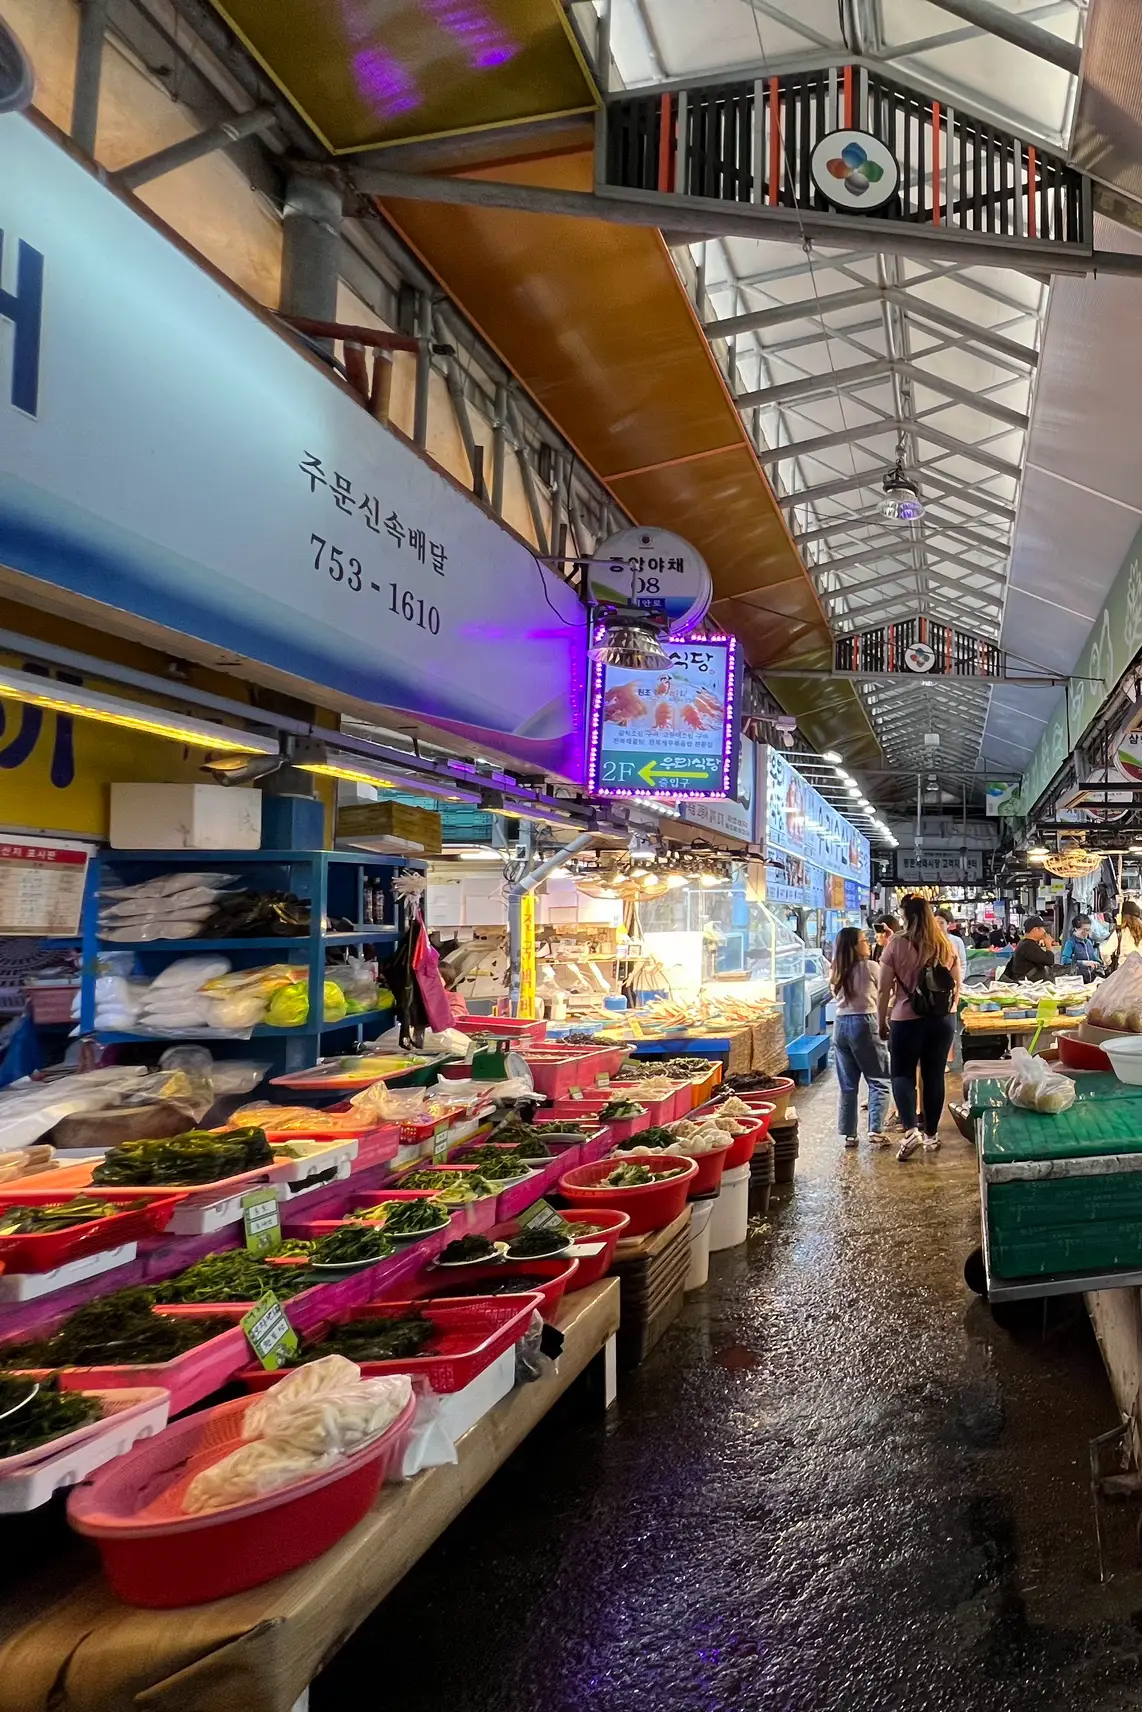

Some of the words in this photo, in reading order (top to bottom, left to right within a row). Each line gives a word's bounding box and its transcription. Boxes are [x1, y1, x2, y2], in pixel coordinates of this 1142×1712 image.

[299, 450, 448, 577] 주문신속배달
[310, 532, 441, 636] 753-1610
[668, 650, 714, 674] 식당
[602, 761, 636, 783] 2F
[659, 756, 722, 772] 우리식당
[658, 777, 691, 789] 출입구
